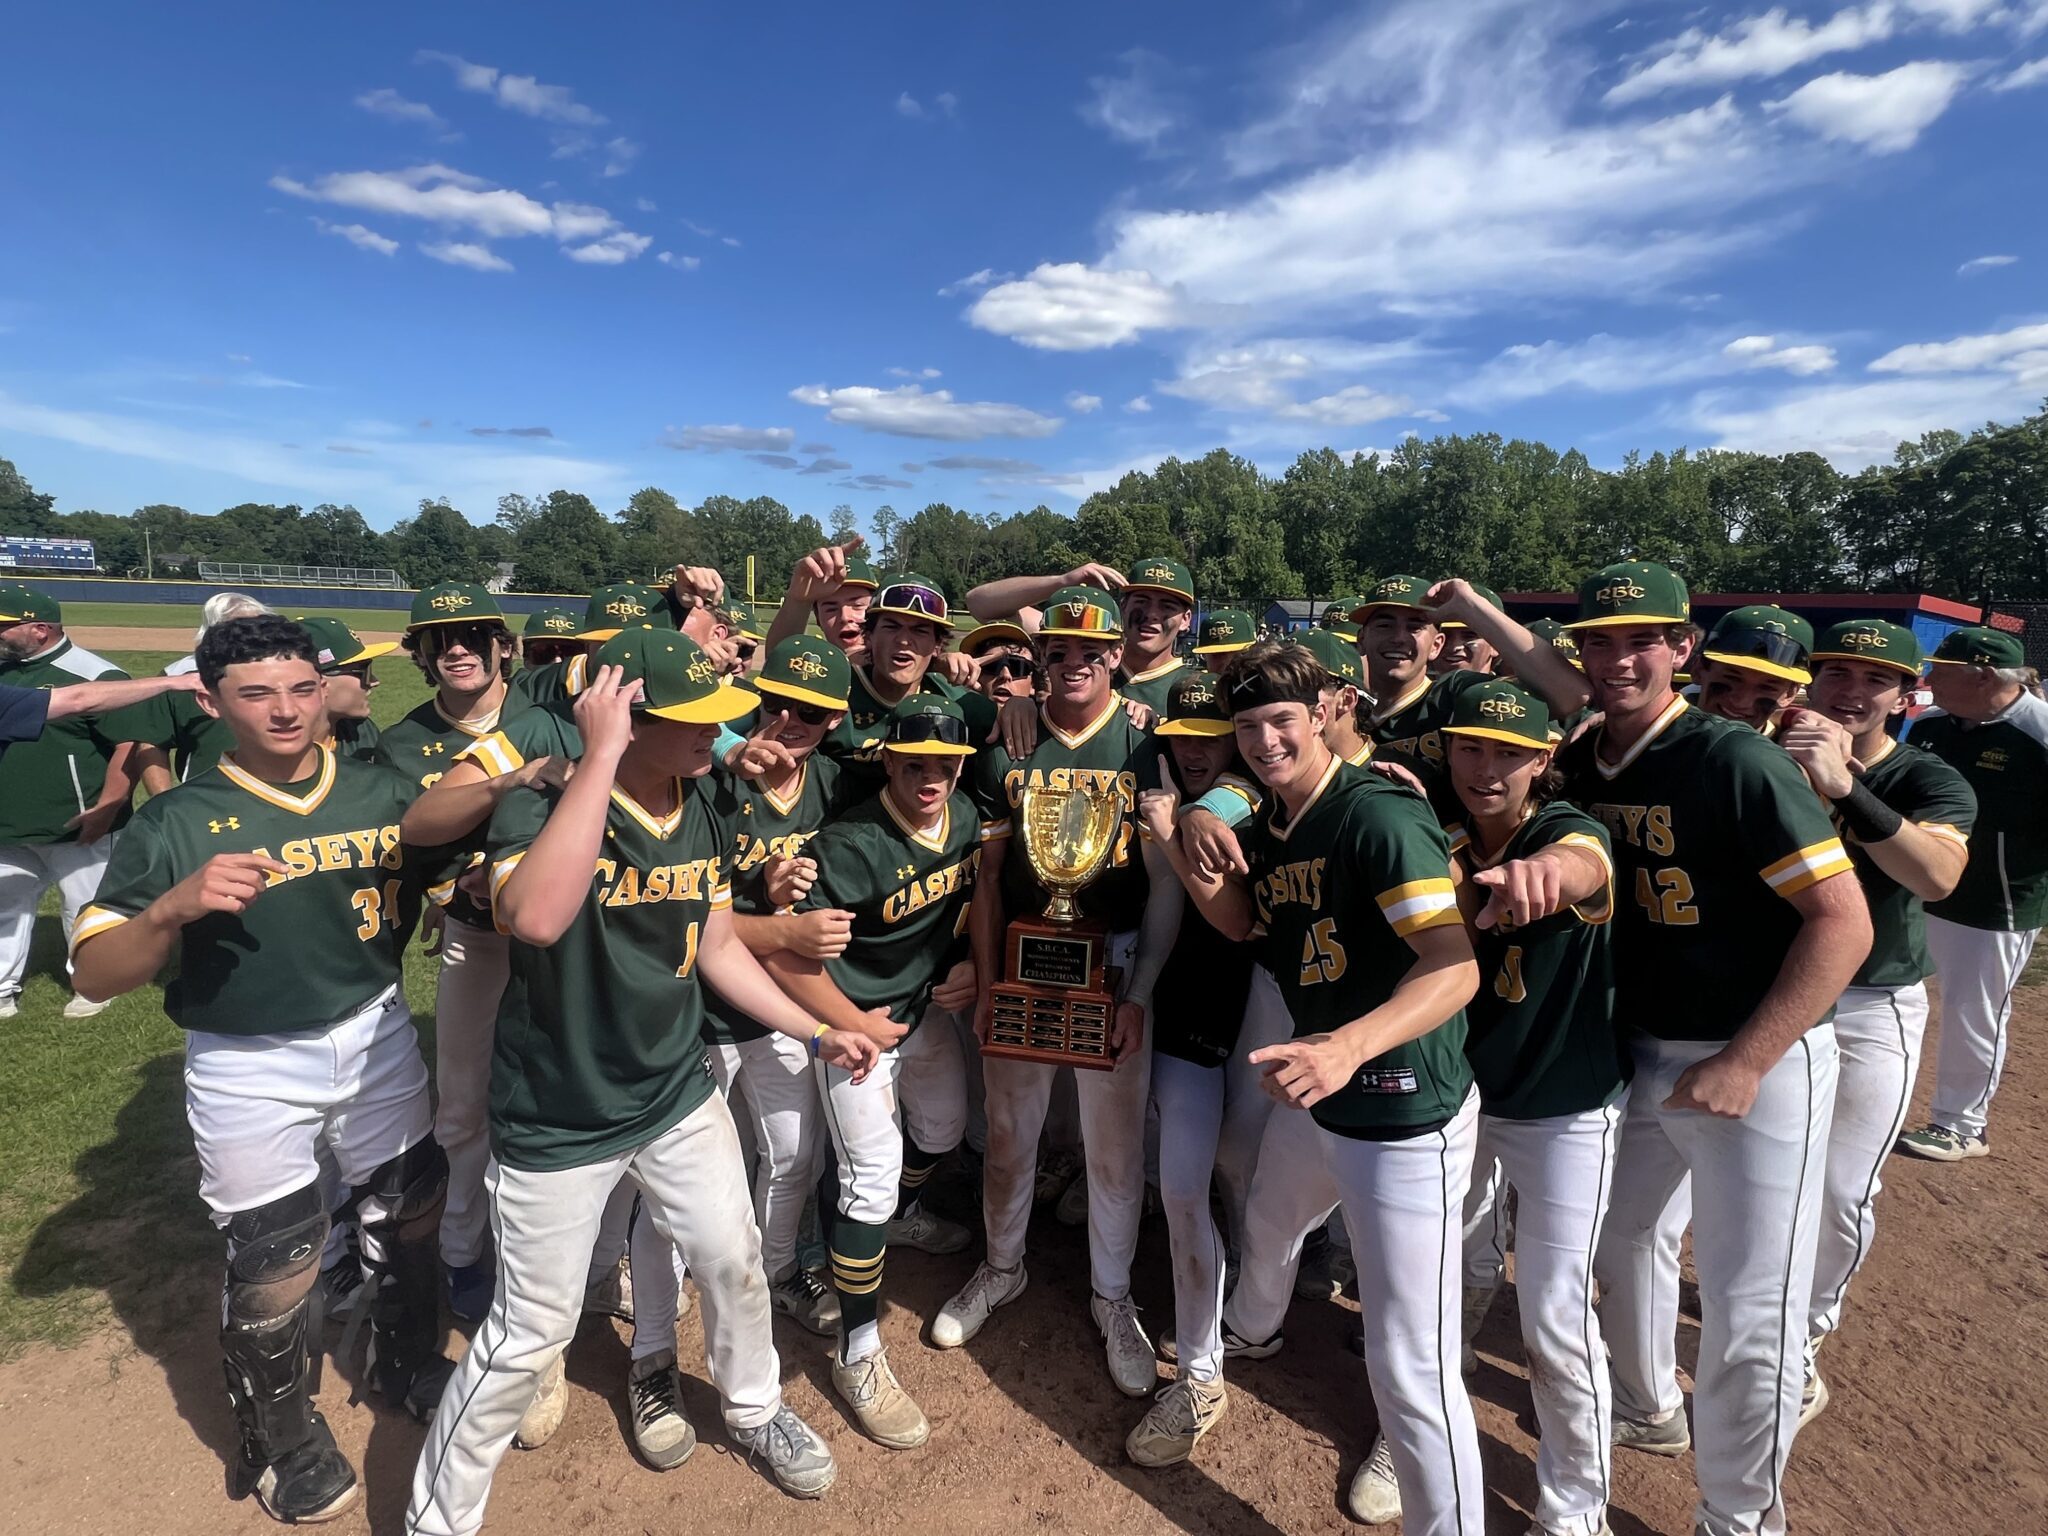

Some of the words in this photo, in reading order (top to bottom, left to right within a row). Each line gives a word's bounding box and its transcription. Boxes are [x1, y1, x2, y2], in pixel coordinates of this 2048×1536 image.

[1145, 568, 1176, 581] RBC
[1376, 582, 1412, 595] RBC
[1596, 586, 1646, 601] RBC
[431, 596, 473, 610] RBC
[606, 602, 648, 617] RBC
[544, 618, 575, 630] RBC
[1209, 625, 1234, 637] RBC
[1841, 633, 1889, 648] RBC
[789, 656, 829, 678] RBC
[1180, 691, 1215, 704] RBC
[1480, 700, 1527, 718] RBC
[252, 824, 404, 888] ASEYS
[1635, 866, 1700, 925] 42
[1299, 916, 1348, 986] 25
[1024, 968, 1082, 983] CHAMPIONS
